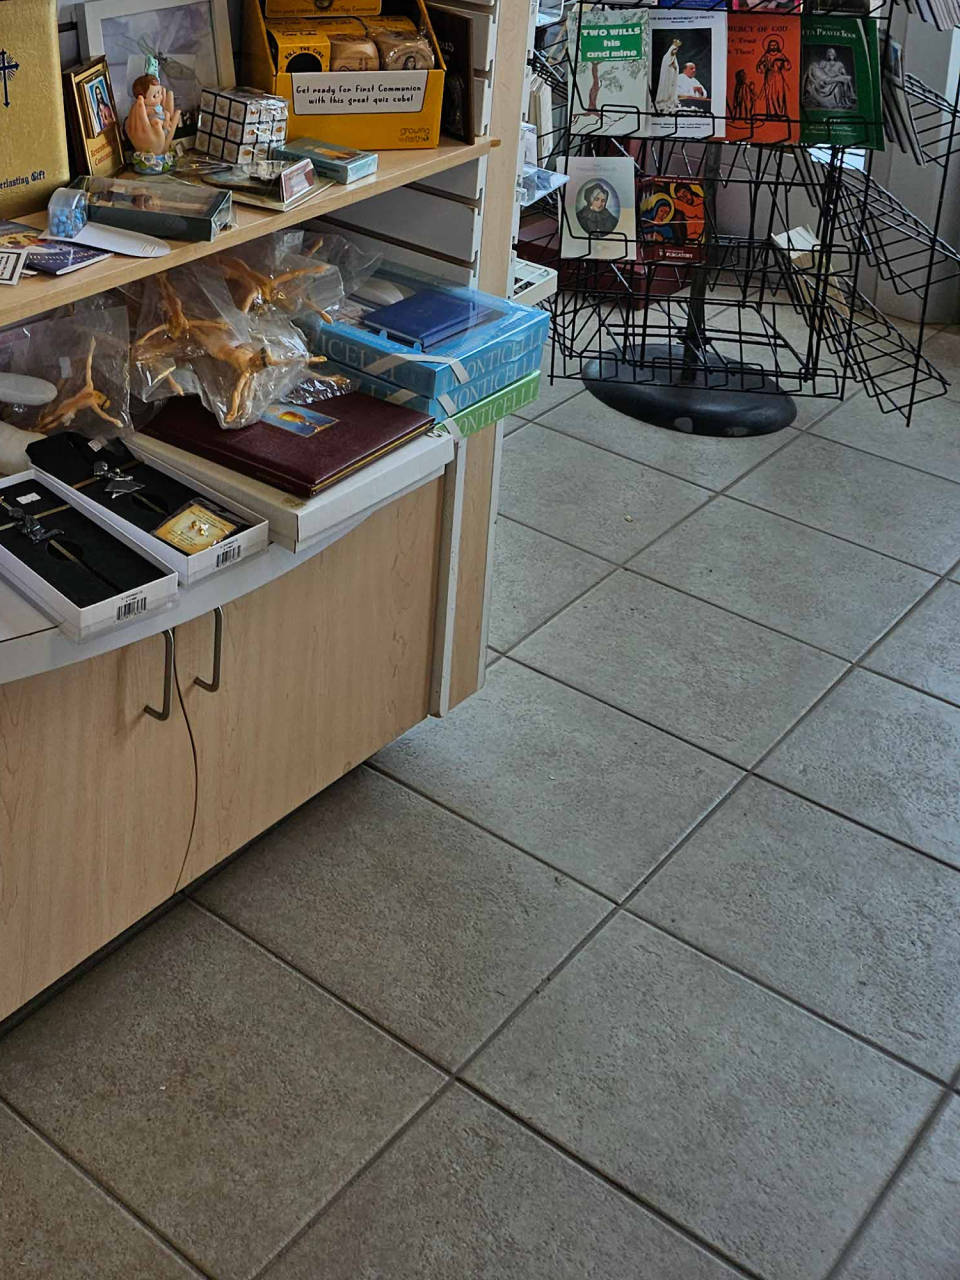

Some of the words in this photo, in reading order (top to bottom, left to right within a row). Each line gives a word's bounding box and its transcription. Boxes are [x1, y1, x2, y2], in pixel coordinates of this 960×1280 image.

[581, 28, 609, 37] TWO
[609, 27, 641, 36] WILLS
[771, 24, 788, 32] GOD
[603, 39, 621, 48] his
[586, 50, 610, 58] and
[610, 49, 637, 58] mine
[295, 85, 310, 94] Get
[312, 85, 336, 96] ready
[339, 85, 352, 93] for
[355, 84, 375, 93] First
[378, 83, 422, 93] Communion
[308, 96, 326, 105] with
[329, 95, 344, 104] this
[348, 95, 369, 106] great
[372, 96, 389, 106] quiz
[399, 127, 430, 137] growing
[30, 169, 46, 182] Gift
